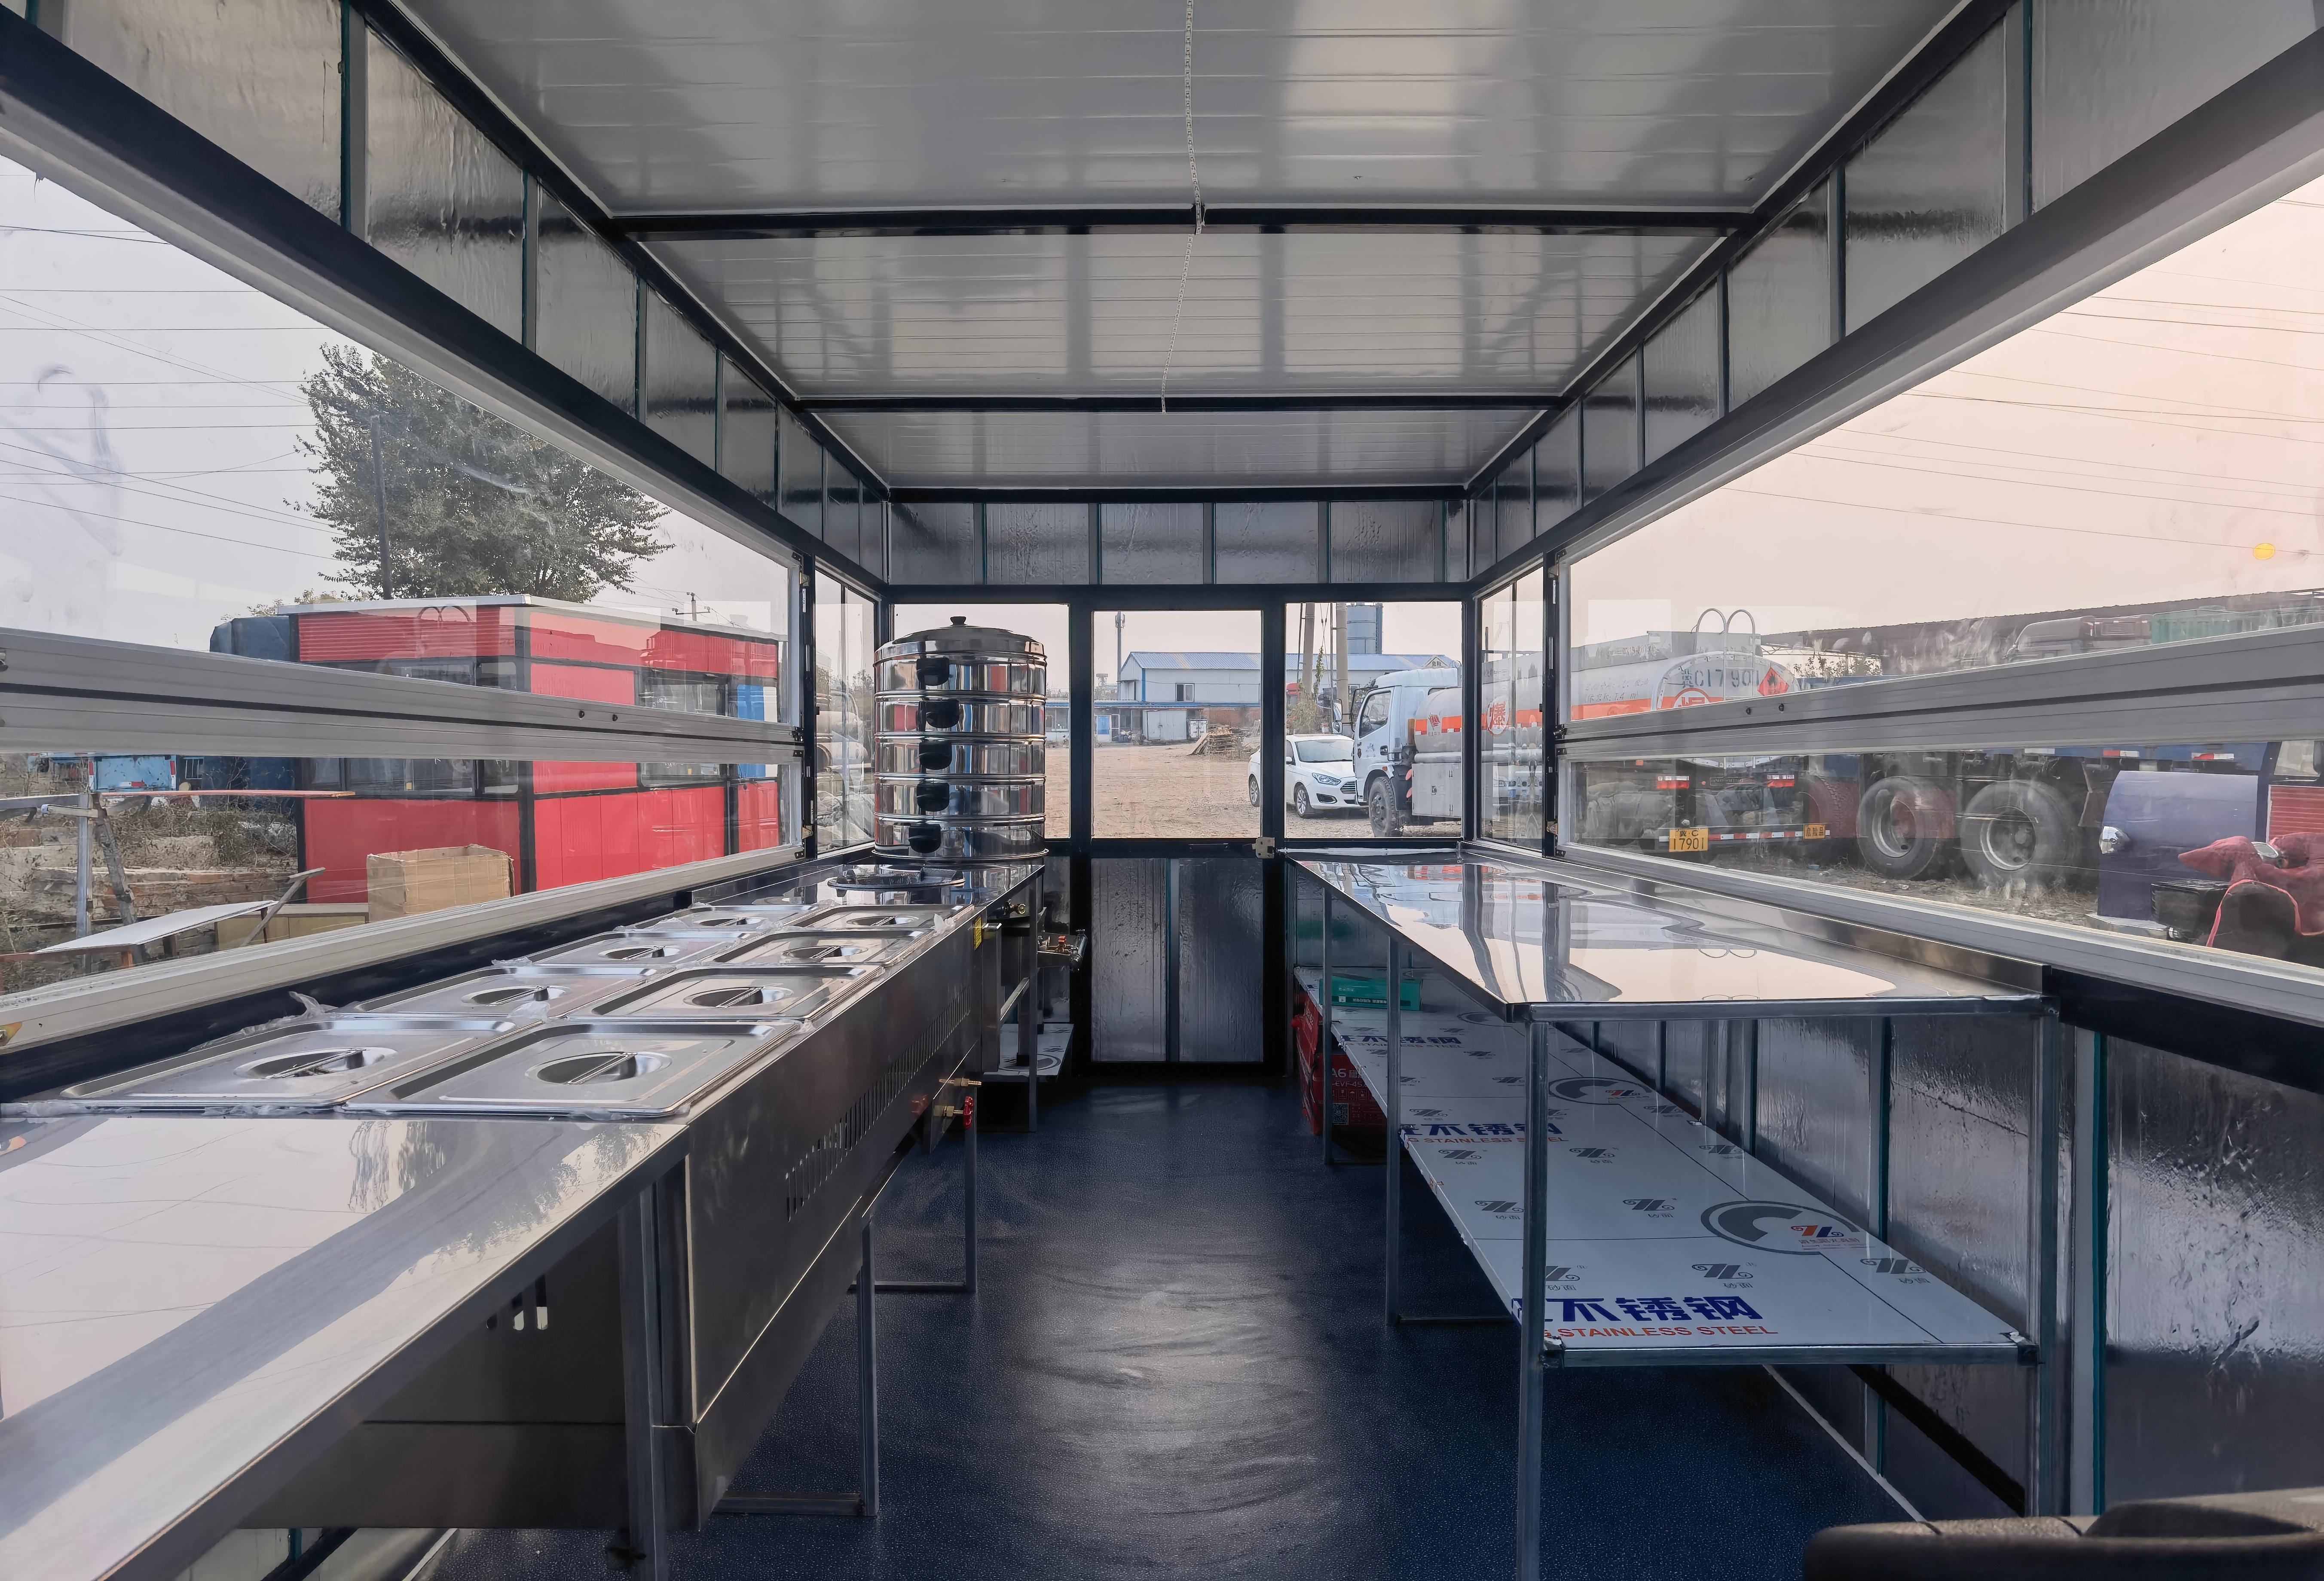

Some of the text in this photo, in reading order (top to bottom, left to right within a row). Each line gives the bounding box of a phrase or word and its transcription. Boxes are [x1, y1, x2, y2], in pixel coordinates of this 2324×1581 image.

[1674, 837, 1704, 850] 17901
[1557, 1327, 1692, 1337] STAINLESS
[1697, 1326, 1779, 1335] STEEL
